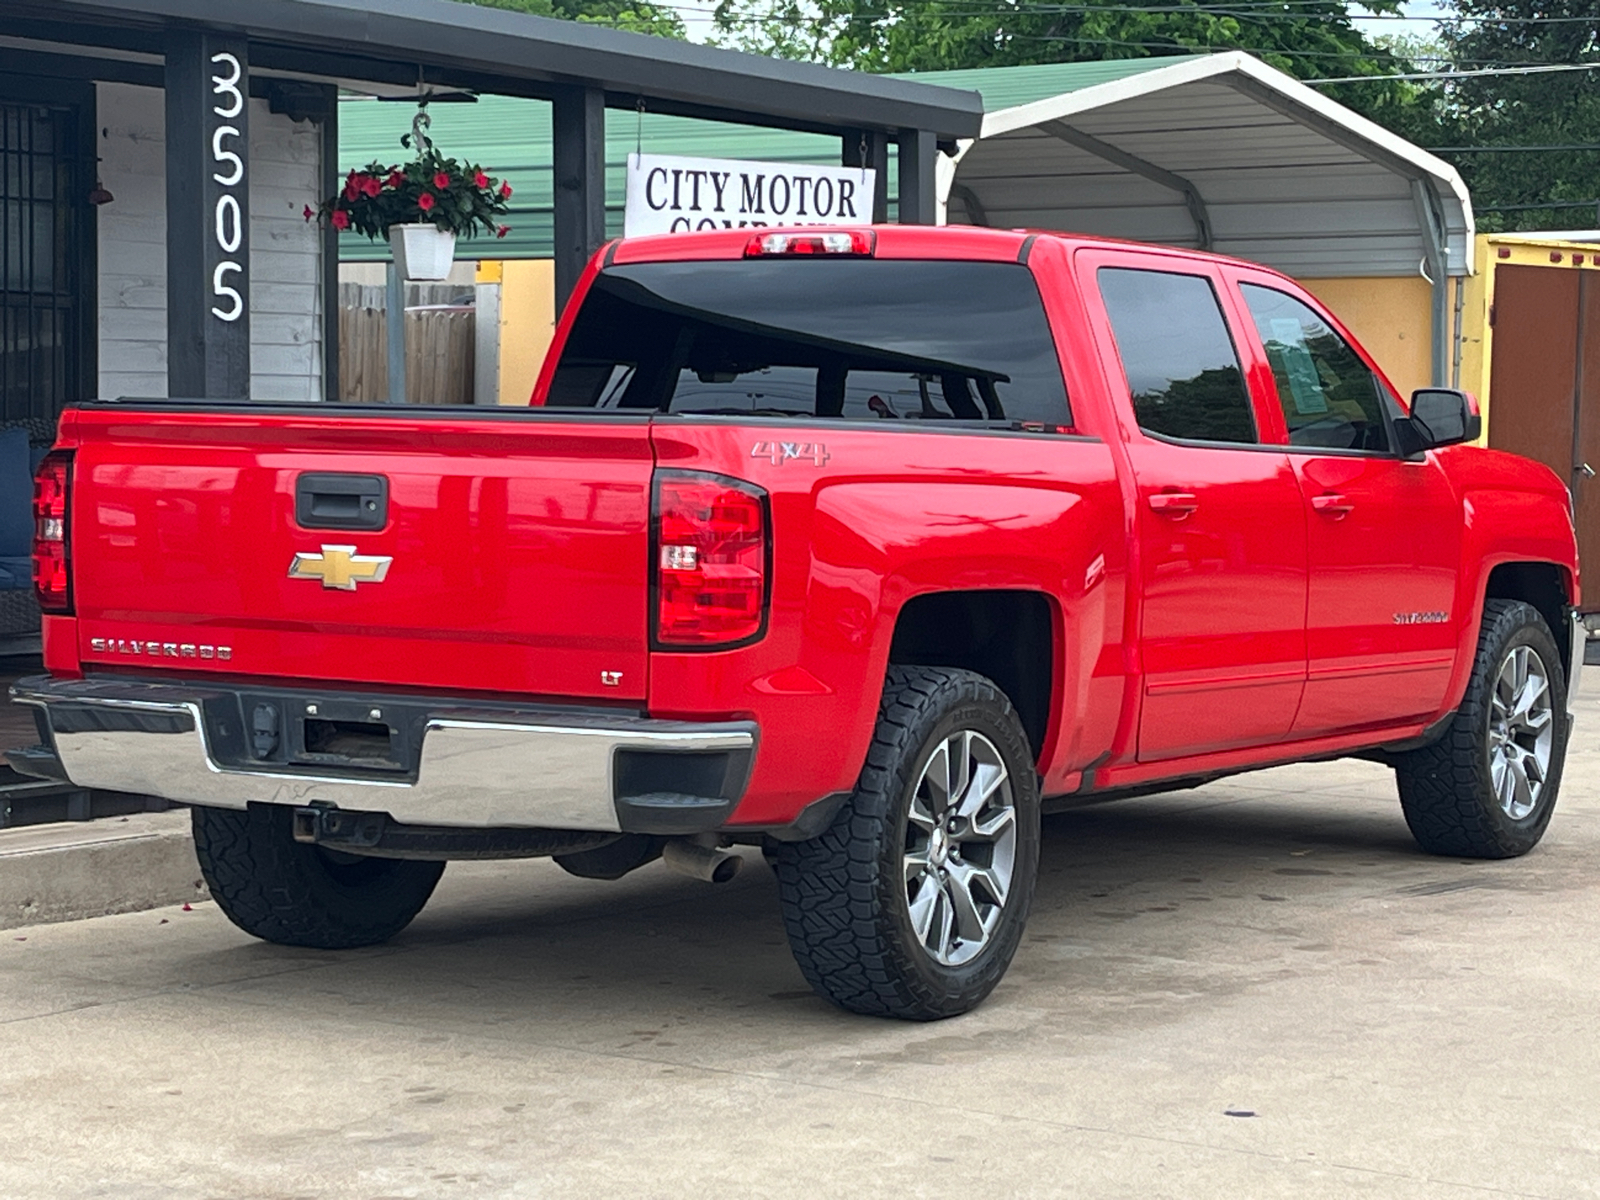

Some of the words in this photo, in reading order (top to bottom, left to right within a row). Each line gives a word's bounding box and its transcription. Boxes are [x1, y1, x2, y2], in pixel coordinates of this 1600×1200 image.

[211, 52, 243, 321] 3505
[645, 167, 731, 212] CITY
[738, 173, 857, 218] MOTOR
[90, 637, 233, 660] SILVERADO
[601, 670, 623, 686] LT
